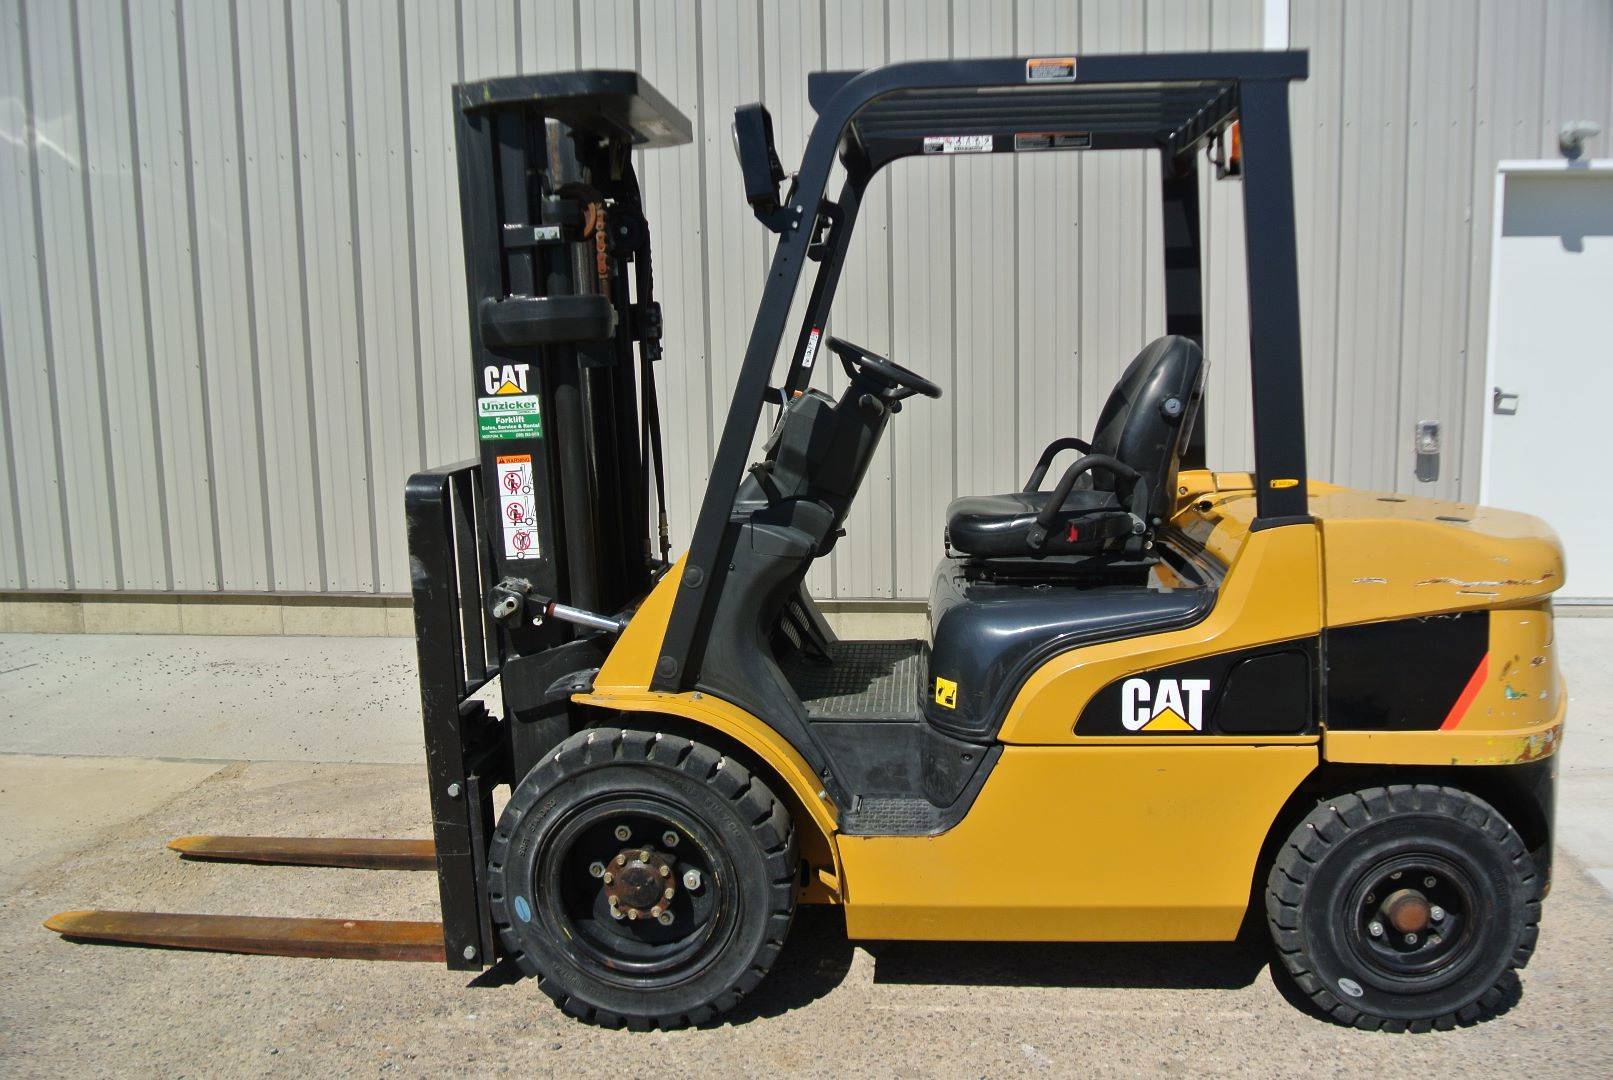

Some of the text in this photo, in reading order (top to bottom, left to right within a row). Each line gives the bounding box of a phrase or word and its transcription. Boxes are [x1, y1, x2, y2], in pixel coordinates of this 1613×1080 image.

[484, 363, 530, 395] CAT
[481, 401, 537, 411] Unzicker
[495, 416, 525, 424] Forklift
[1121, 678, 1211, 731] CAT
